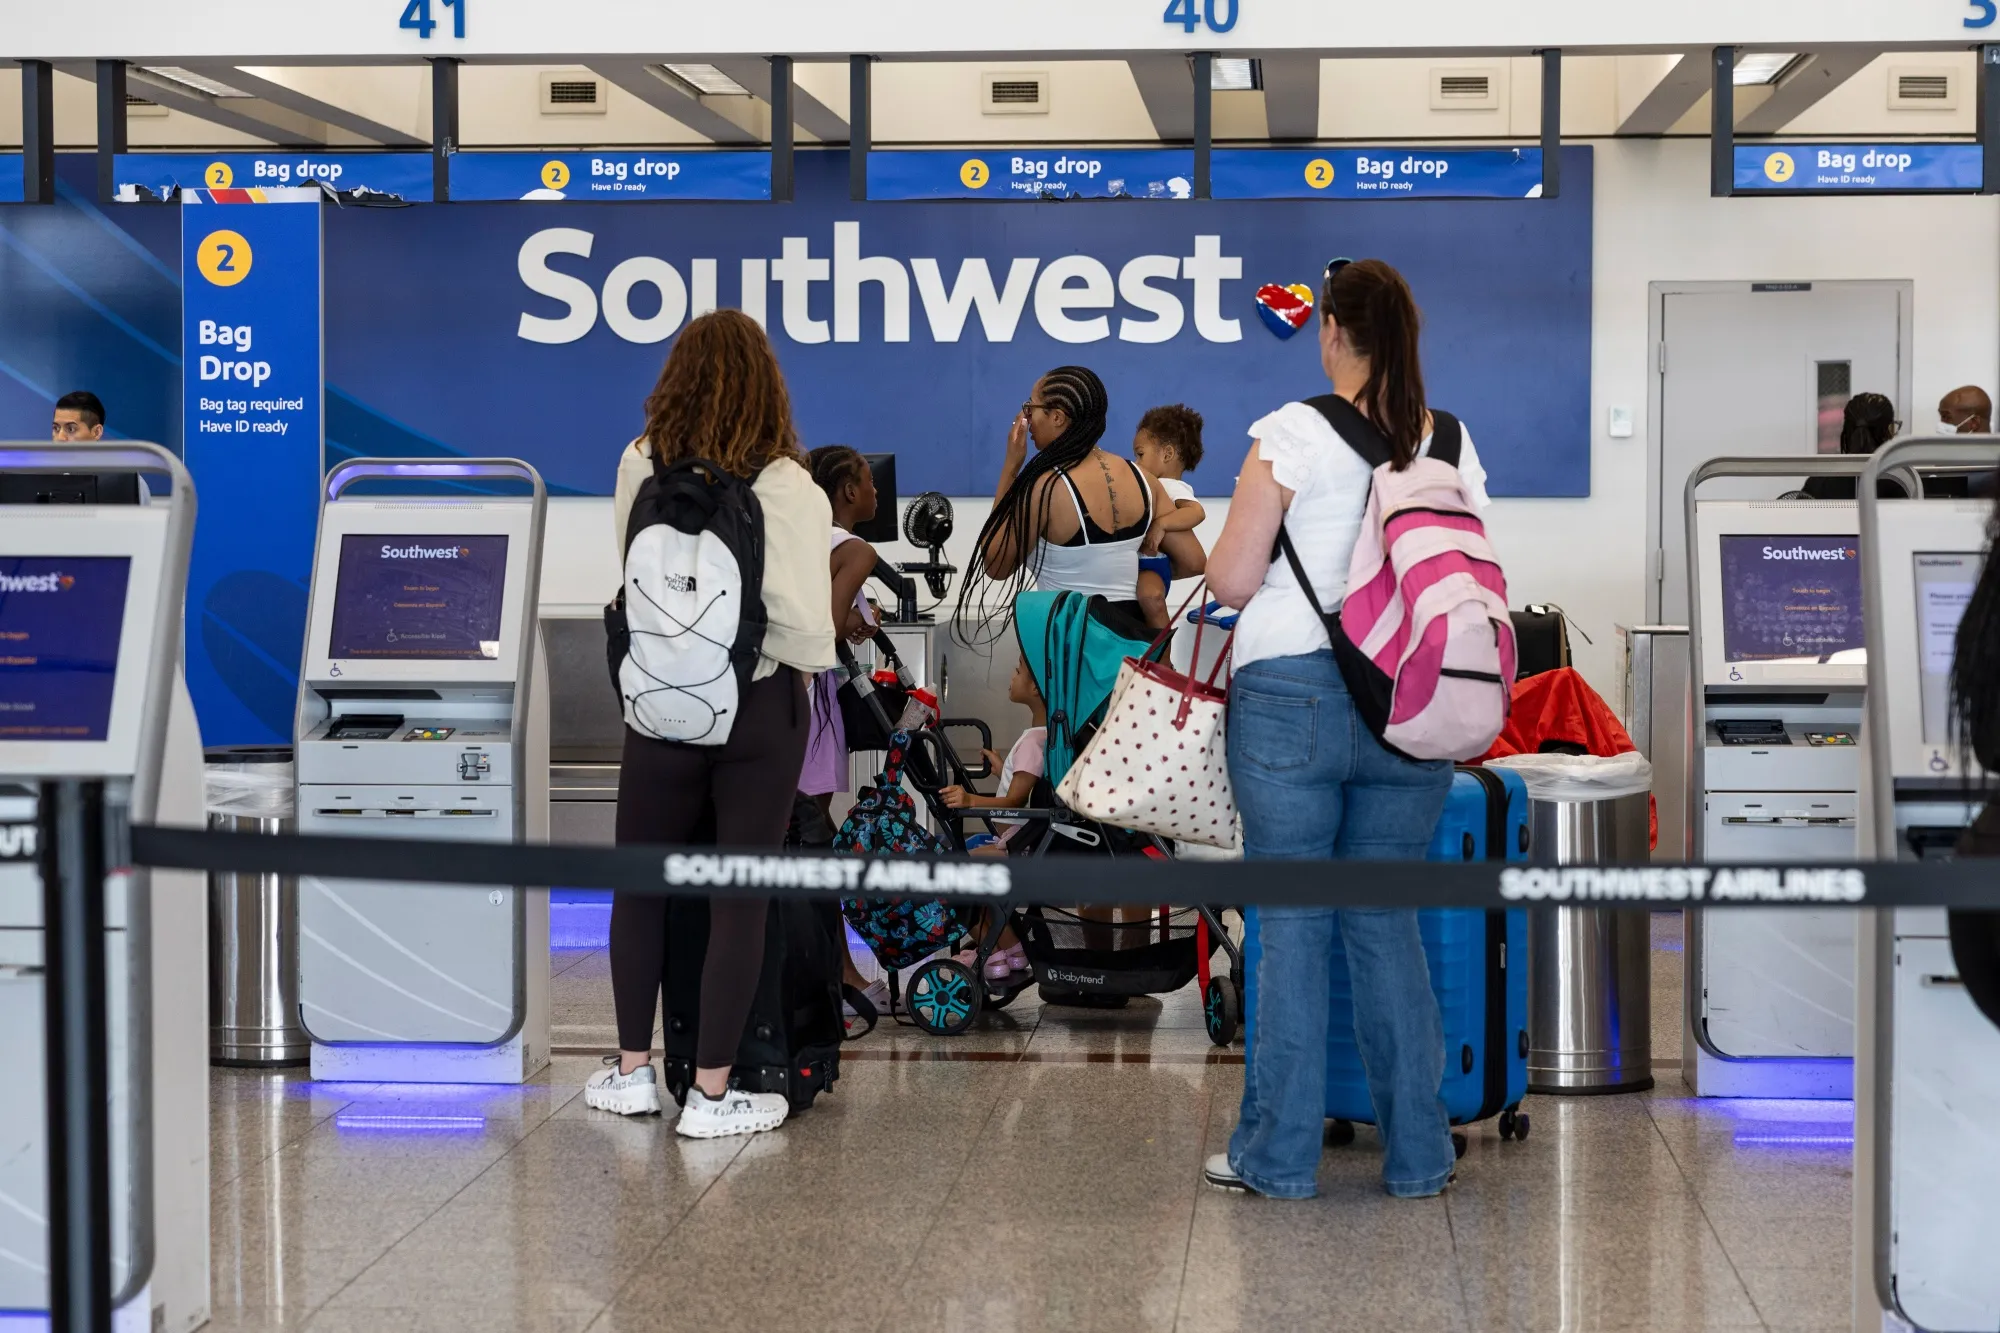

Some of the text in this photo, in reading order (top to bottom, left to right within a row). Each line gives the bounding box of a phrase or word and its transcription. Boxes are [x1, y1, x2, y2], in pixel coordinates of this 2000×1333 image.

[398, 0, 466, 39] 41
[1163, 0, 1240, 34] 40
[591, 158, 680, 181] Bag drop
[1011, 156, 1102, 179] Bag drop
[1356, 156, 1449, 179] Bag drop
[1775, 160, 1785, 174] 2
[1817, 149, 1912, 173] Bag drop
[214, 169, 225, 184] 2
[254, 159, 343, 182] Bag drop
[551, 168, 561, 182] 2
[970, 166, 980, 181] 2
[1315, 166, 1325, 181] 2
[591, 183, 647, 192] Have ID ready
[1011, 181, 1032, 190] Have
[1044, 181, 1067, 191] ready
[1356, 181, 1414, 191] Have ID ready
[1817, 175, 1876, 185] Have ID ready
[216, 244, 235, 272] 2
[516, 220, 1243, 345] Southwest
[199, 319, 252, 352] Bag
[200, 355, 271, 388] Drop
[200, 397, 303, 414] Bag tag required
[200, 419, 289, 435] Have ID ready
[380, 545, 459, 559] Southwest
[1762, 546, 1846, 560] Southwest
[663, 853, 1012, 896] SOUTHWEST AIRLINES
[1499, 867, 1866, 901] SOUTHWEST AIRLINES
[1059, 970, 1104, 985] babytrend
